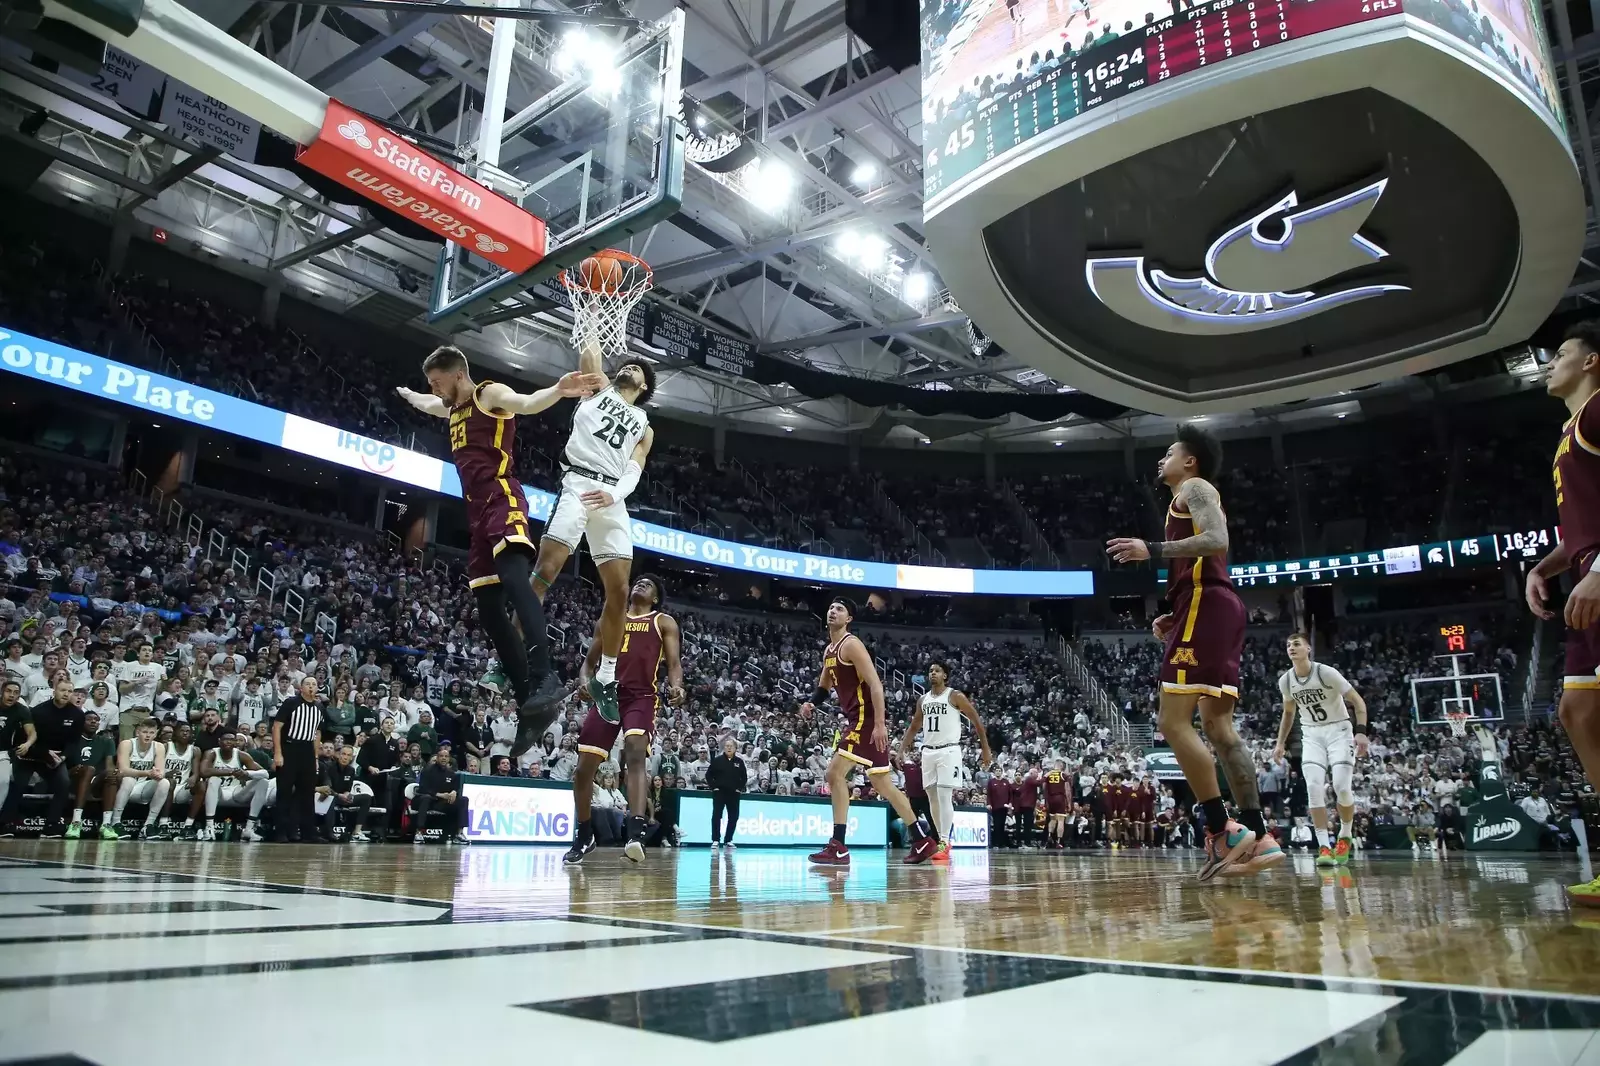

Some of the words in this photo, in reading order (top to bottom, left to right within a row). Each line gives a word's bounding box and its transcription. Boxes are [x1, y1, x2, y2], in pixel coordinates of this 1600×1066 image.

[1361, 4, 1370, 13] 4
[1373, 0, 1397, 12] FLS
[1146, 19, 1173, 37] PLYR
[1188, 6, 1208, 20] PTS
[1212, 0, 1234, 11] REB
[1157, 34, 1163, 42] 1
[1195, 20, 1202, 29] 2
[1221, 11, 1228, 19] 2
[1247, 2, 1255, 10] 0
[1158, 43, 1165, 52] 2
[1195, 29, 1204, 38] 11
[1222, 20, 1229, 29] 2
[1249, 11, 1256, 20] 3
[1277, 3, 1283, 11] 1
[1159, 52, 1166, 61] 3
[1196, 38, 1206, 47] 11
[1223, 29, 1231, 38] 4
[1250, 20, 1257, 29] 0
[1278, 12, 1285, 20] 1
[1160, 61, 1167, 69] 4
[1199, 47, 1205, 56] 5
[1224, 39, 1231, 47] 0
[1252, 30, 1258, 38] 1
[1279, 21, 1287, 30] 0
[1159, 69, 1170, 80] 23
[1200, 56, 1206, 66] 2
[1226, 47, 1233, 57] 3
[1252, 39, 1260, 48] 0
[1280, 31, 1288, 40] 0
[1084, 47, 1145, 86] 16:24
[90, 74, 119, 97] 24
[979, 104, 999, 121] PLYR
[1008, 90, 1023, 103] PTS
[1026, 79, 1042, 93] REB
[1046, 68, 1062, 83] AST
[1071, 61, 1077, 70] F
[1051, 81, 1057, 91] 2
[1071, 71, 1077, 80] 0
[1105, 76, 1123, 90] 2ND
[1128, 78, 1144, 90] POSS
[204, 96, 228, 111] JUD
[1032, 100, 1038, 109] 2
[1052, 90, 1057, 99] 2
[1072, 80, 1078, 89] 0
[1087, 95, 1102, 107] POSS
[175, 92, 251, 135] HEATHCOTE
[1033, 109, 1038, 118] 2
[1052, 98, 1058, 107] 6
[1052, 106, 1058, 116] 0
[177, 108, 206, 126] HEAD
[207, 123, 244, 144] COACH
[182, 121, 205, 137] 1976
[213, 135, 235, 151] 1995
[944, 119, 975, 157] 45
[986, 152, 995, 160] 25
[1014, 136, 1021, 145] 11
[1034, 126, 1039, 135] 5
[1053, 116, 1059, 125] 2
[660, 312, 695, 333] WOMEN'S
[663, 322, 676, 333] BIG
[678, 328, 692, 340] TEN
[654, 325, 700, 350] CHAMPIONS
[667, 341, 685, 355] 2011
[713, 334, 750, 352] WOMEN'S
[707, 347, 755, 368] CHAMPIONS
[716, 343, 730, 353] BIG
[732, 348, 746, 358] TEN
[0, 331, 93, 385] our
[102, 364, 215, 421] Plate
[720, 359, 740, 373] 2014
[597, 396, 642, 437] STATE
[450, 421, 467, 452] 23
[592, 416, 629, 450] 25
[1460, 539, 1480, 556] 45
[1503, 529, 1549, 551] 16:24
[631, 523, 697, 557] Smile
[702, 540, 735, 565] On
[739, 547, 799, 574] Your
[804, 557, 865, 582] Plate
[1268, 575, 1277, 584] 15
[1291, 573, 1297, 582] 4
[1311, 571, 1321, 580] 15
[1333, 569, 1339, 578] 1
[1353, 567, 1359, 576] 1
[1372, 565, 1378, 574] 5
[1387, 563, 1398, 572] TOL
[624, 622, 650, 633] NESOTA
[1440, 625, 1465, 636] 16:23
[620, 633, 631, 653] 1
[1447, 636, 1465, 651] 19
[429, 687, 443, 700] 35
[251, 709, 255, 719] 1
[1306, 703, 1328, 723] 15
[927, 716, 940, 732] 11
[1048, 775, 1060, 784] 33
[720, 811, 803, 837] eekend
[806, 815, 858, 837] Pla?
[1473, 821, 1516, 844] LIBMAN
